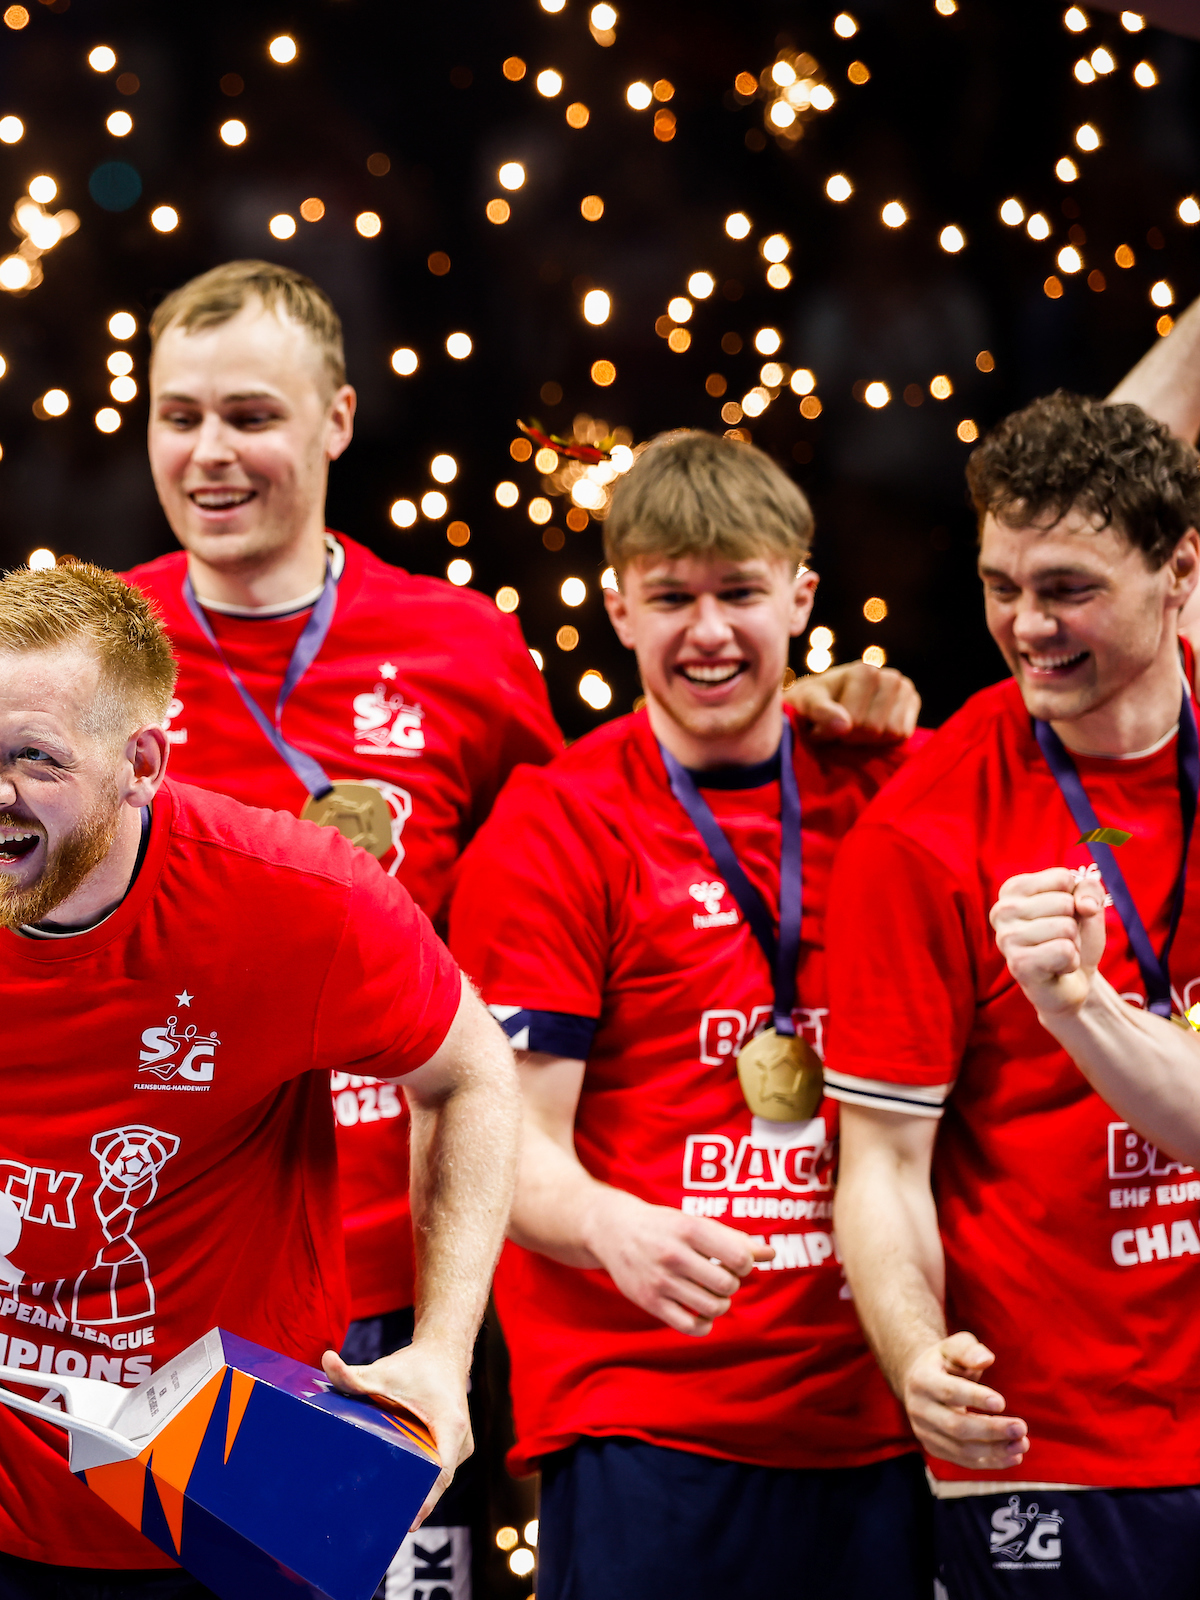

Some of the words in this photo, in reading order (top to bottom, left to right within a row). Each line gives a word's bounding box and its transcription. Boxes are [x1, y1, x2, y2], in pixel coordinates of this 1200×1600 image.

[353, 691, 425, 750] SG
[138, 1022, 218, 1082] SG
[133, 1083, 211, 1092] FLENSBURG-HANDEWITT
[332, 1083, 402, 1128] 025
[681, 1196, 729, 1217] EHF
[1109, 1186, 1151, 1210] EHF
[70, 1323, 156, 1351] LEAGUE
[990, 1505, 1062, 1561] SG
